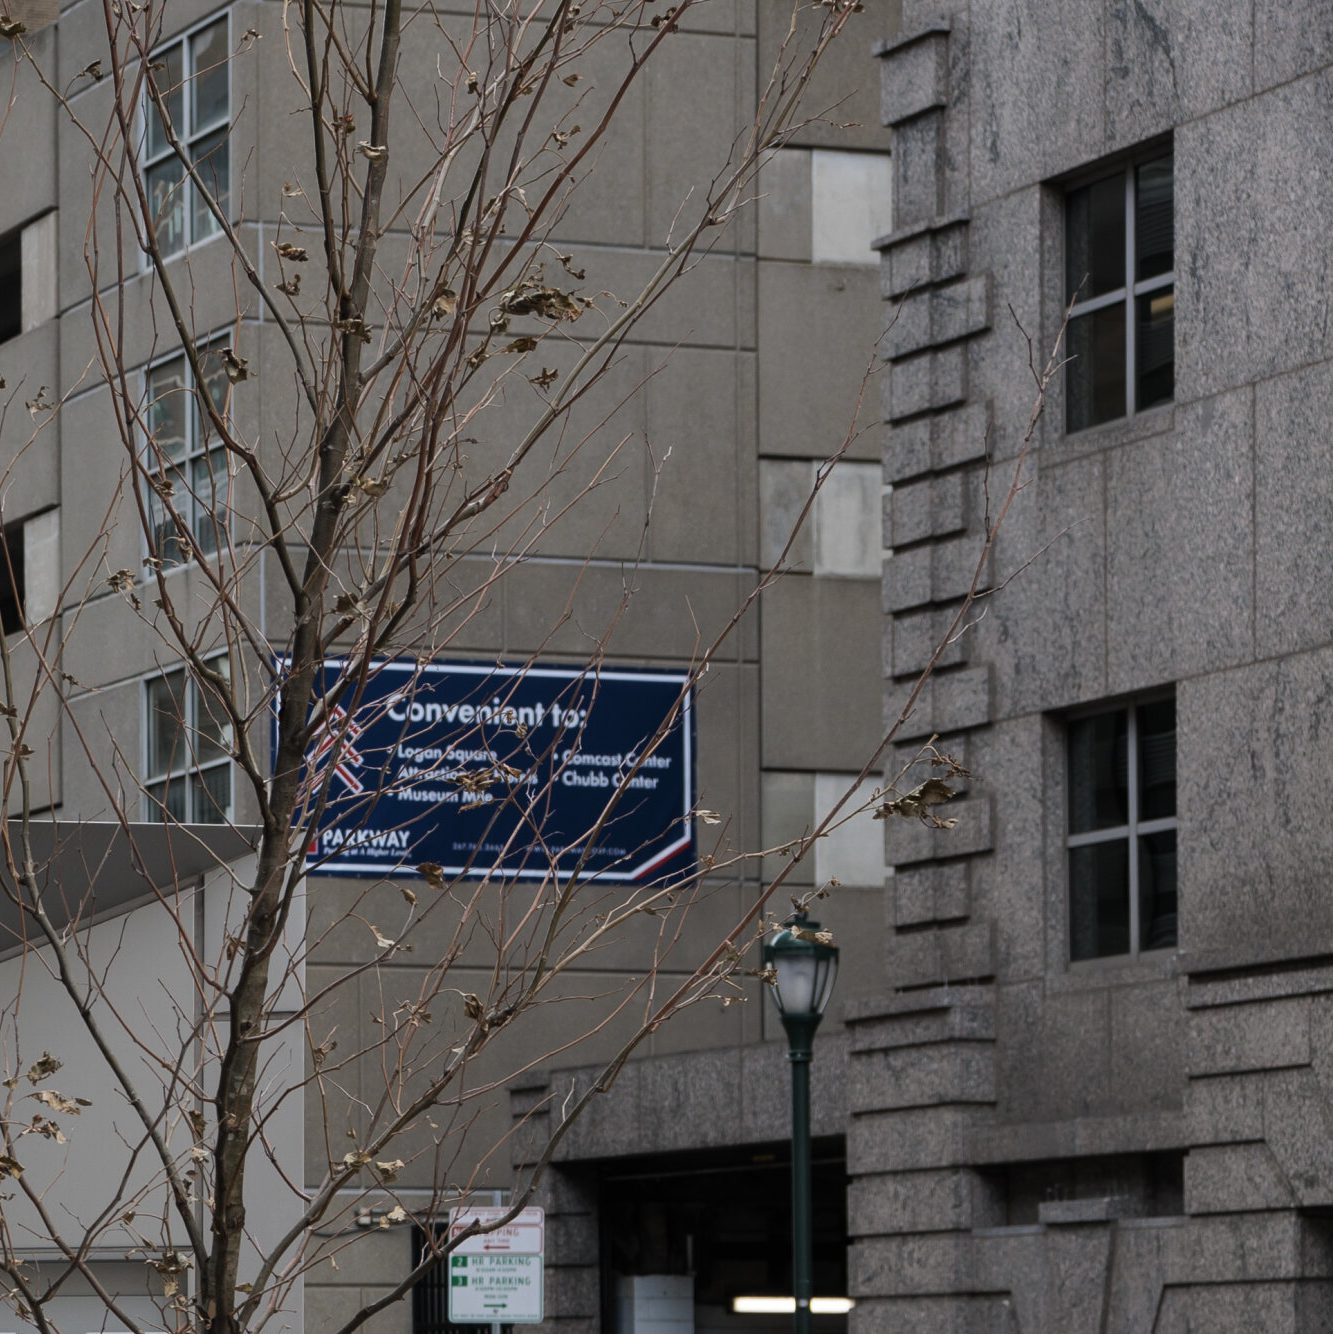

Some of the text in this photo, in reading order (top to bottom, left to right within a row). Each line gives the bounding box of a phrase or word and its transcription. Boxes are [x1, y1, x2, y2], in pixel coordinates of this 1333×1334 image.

[387, 694, 587, 729] Convenient to:
[397, 744, 497, 765] Logan Square
[562, 749, 622, 767] Comcast
[397, 764, 472, 782] Attractio
[562, 771, 609, 788] Chubb
[397, 786, 459, 803] Museum
[322, 828, 410, 848] PARKWAY
[471, 1256, 485, 1266] HR
[489, 1256, 531, 1267] PARKING
[471, 1276, 485, 1286] HR
[489, 1276, 531, 1287] PARKING
